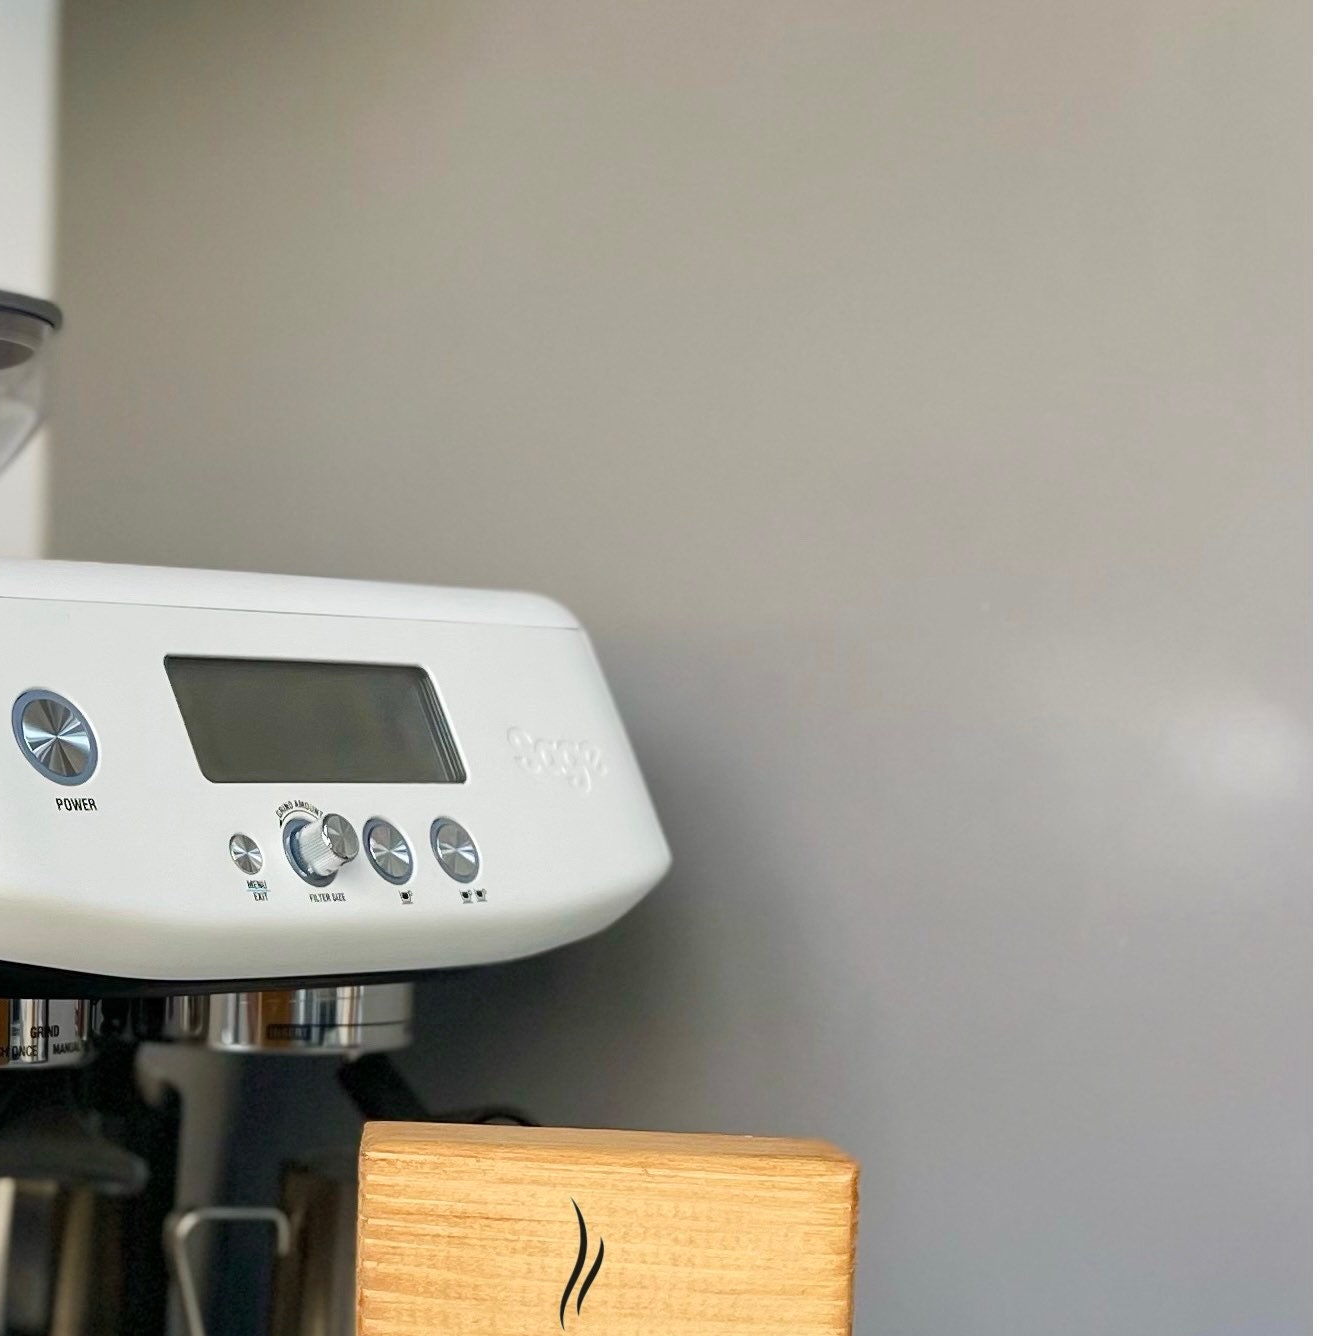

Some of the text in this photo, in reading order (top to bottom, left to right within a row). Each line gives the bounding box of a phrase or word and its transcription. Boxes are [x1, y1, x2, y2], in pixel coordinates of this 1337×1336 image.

[55, 797, 98, 811] POWER
[253, 892, 269, 901] EXIT
[309, 892, 346, 902] FILTER SIZE
[30, 1025, 60, 1039] GRIND
[11, 1045, 39, 1058] ONCE
